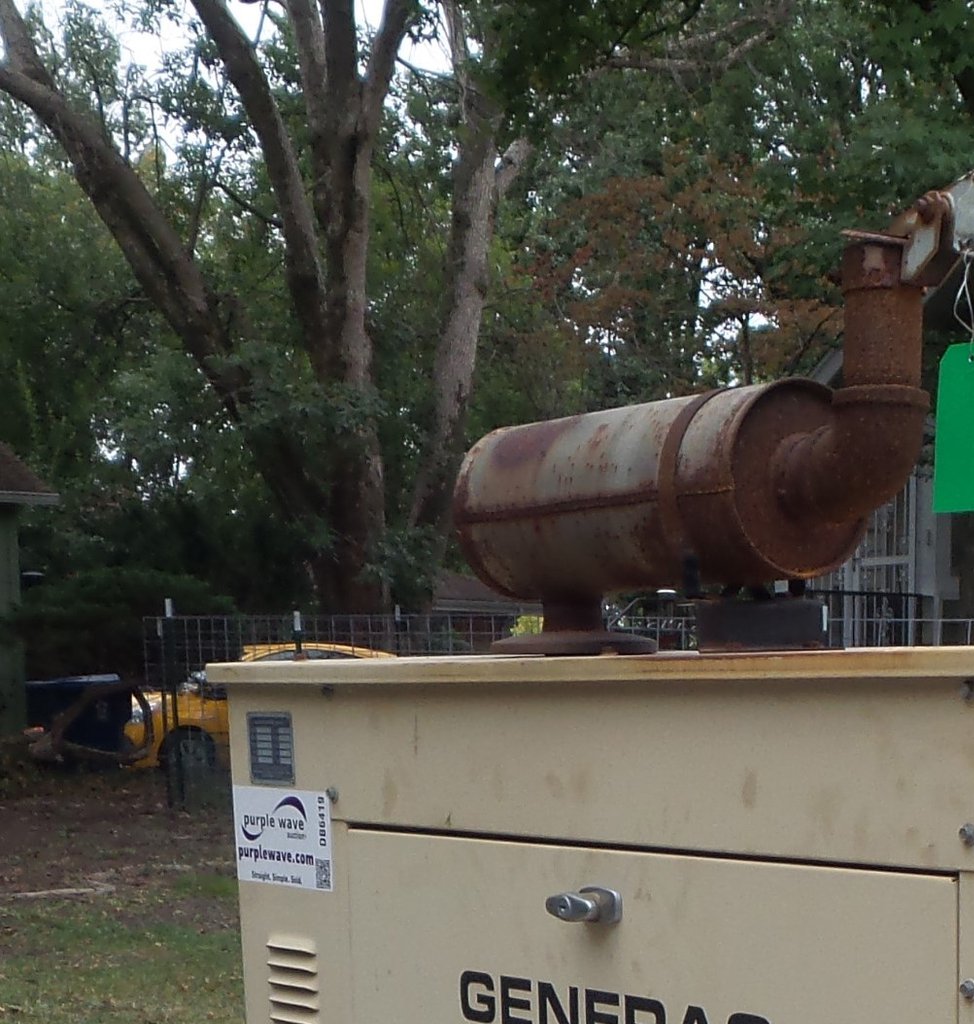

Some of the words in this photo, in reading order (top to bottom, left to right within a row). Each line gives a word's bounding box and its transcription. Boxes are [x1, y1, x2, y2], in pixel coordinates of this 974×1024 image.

[243, 813, 275, 831] purple
[278, 817, 305, 831] wave
[238, 844, 314, 866] purplewave.com
